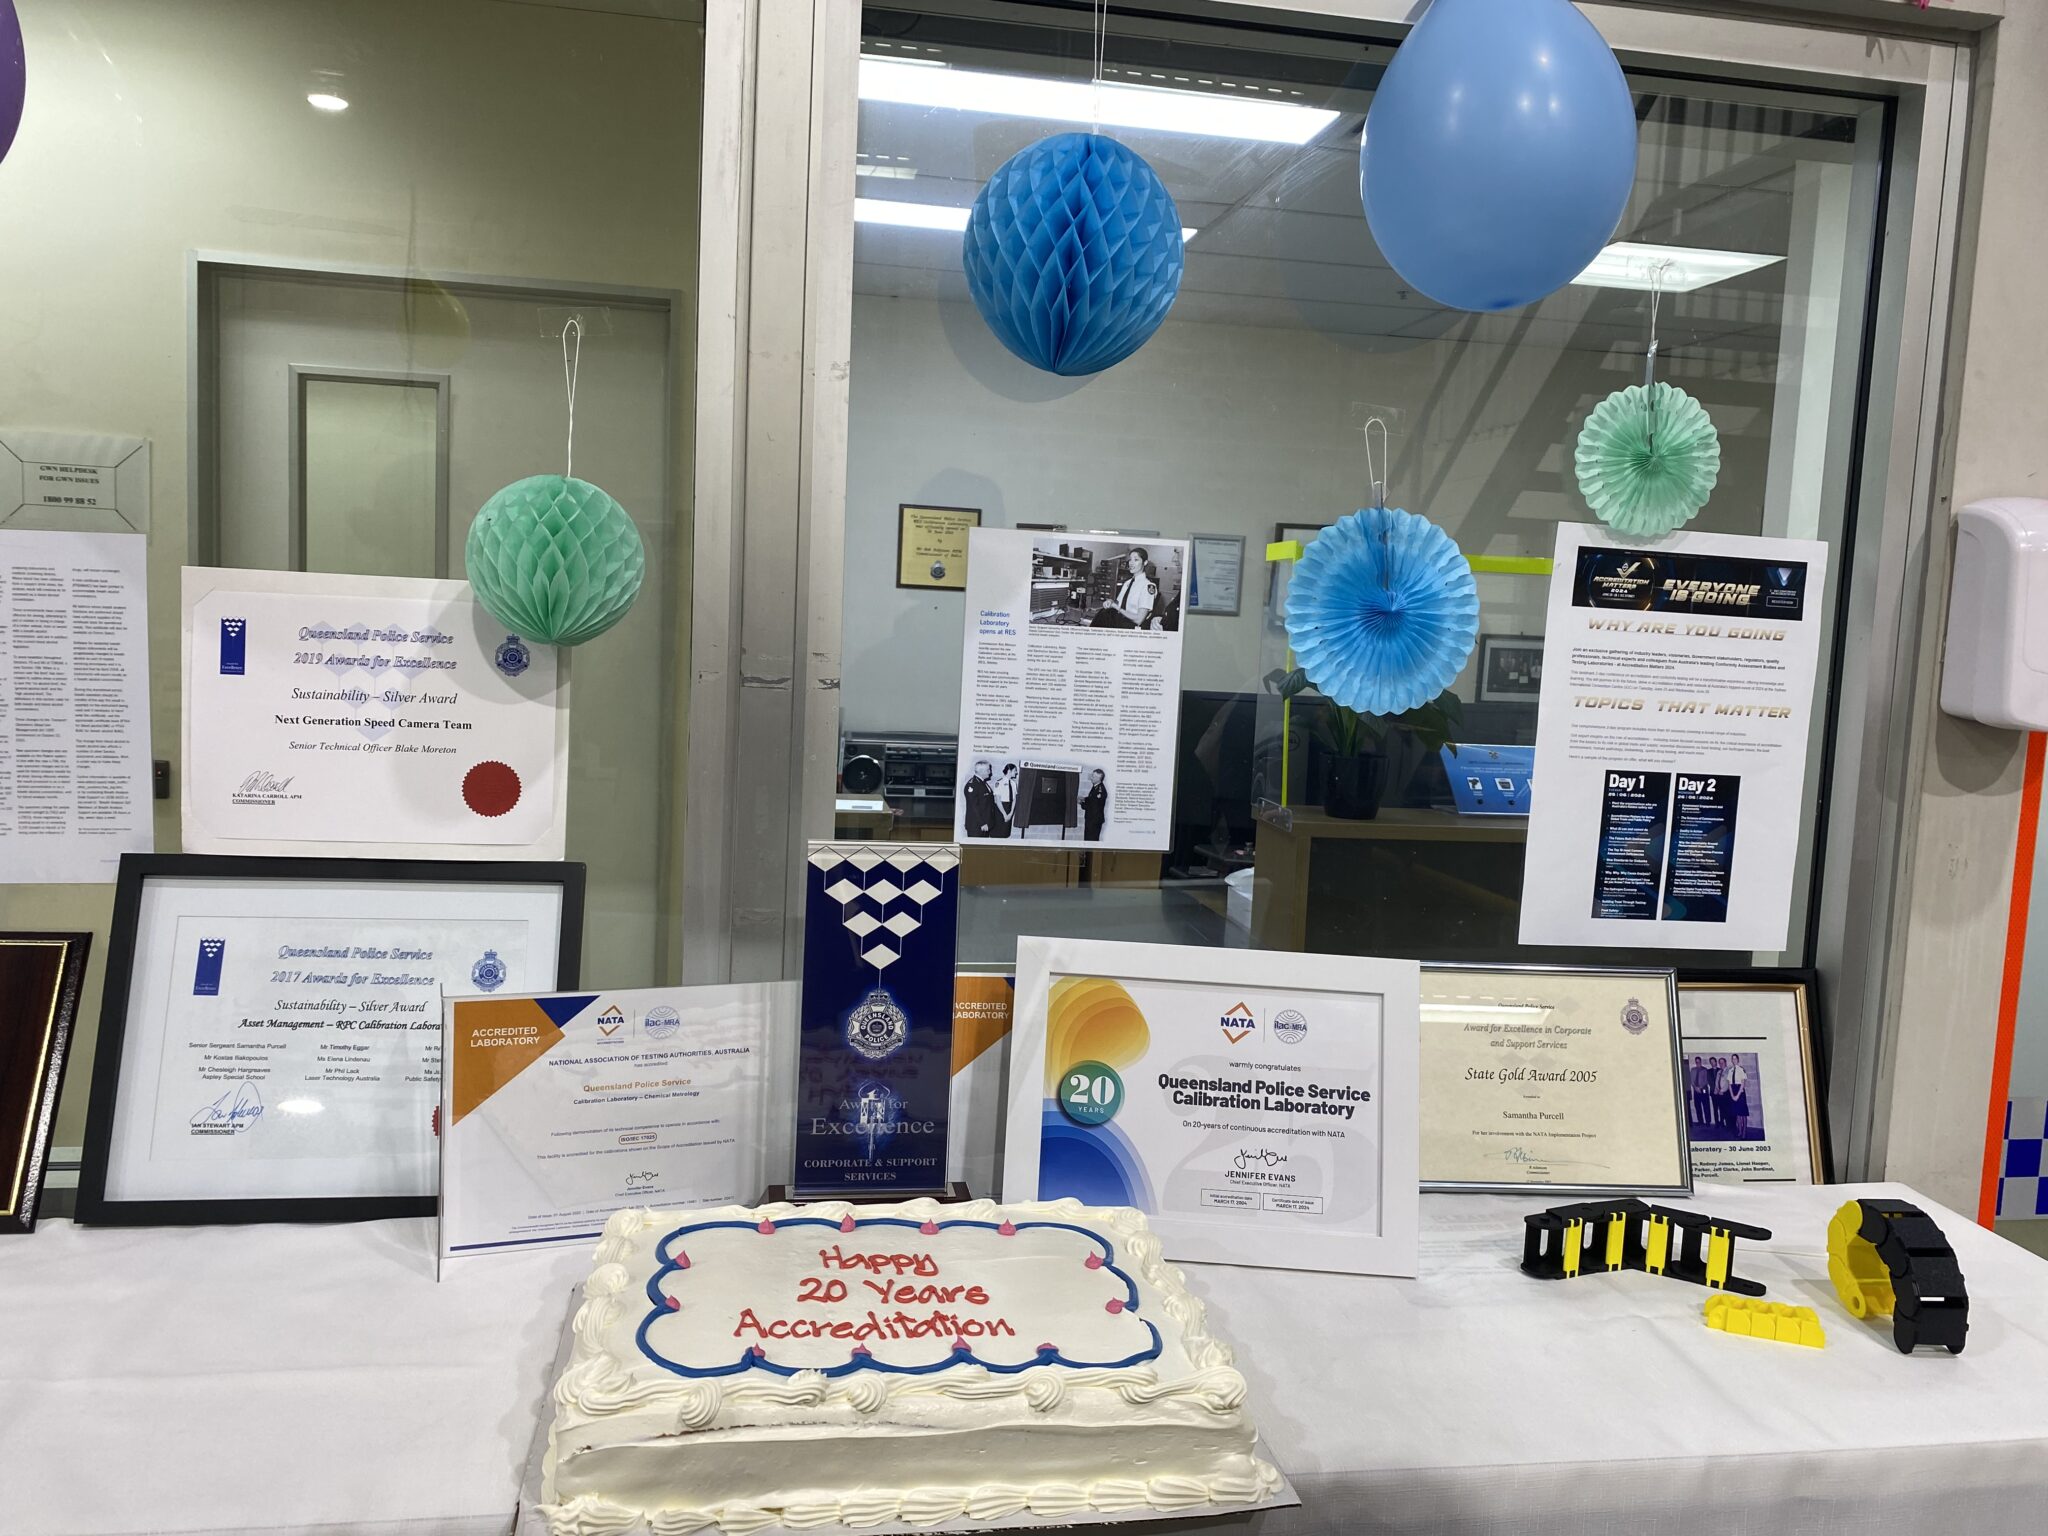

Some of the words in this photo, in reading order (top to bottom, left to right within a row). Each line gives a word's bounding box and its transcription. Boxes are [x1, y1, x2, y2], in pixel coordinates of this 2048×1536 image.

[1663, 578, 1761, 596] EVERYONE
[1669, 589, 1691, 602] IS
[1692, 591, 1751, 606] GOING
[980, 610, 1010, 618] Calibration
[299, 626, 370, 641] Queensland
[372, 628, 408, 643] Police
[410, 631, 454, 644] Service
[1588, 617, 1634, 632] WHY
[1637, 621, 1675, 634] ARE
[1684, 625, 1722, 637] YOU
[1728, 627, 1787, 641] GOING
[293, 652, 323, 665] 2019
[325, 654, 370, 667] Awards
[371, 655, 391, 669] for
[393, 656, 457, 670] Excellence
[292, 687, 370, 704] Sustainability
[383, 690, 417, 703] Silver
[418, 692, 458, 704] Award
[1573, 696, 1646, 711] TOPICS
[1657, 700, 1711, 714] THAT
[1714, 704, 1792, 719] MATTER
[275, 715, 300, 725] Next
[302, 715, 361, 726] Generation
[364, 717, 395, 729] Speed
[398, 718, 440, 729] Camera
[442, 720, 472, 730] Team
[289, 741, 317, 750] Senior
[319, 742, 360, 751] Technical
[362, 743, 393, 753] Officer
[394, 744, 419, 753] Blake
[421, 745, 457, 754] Moreton
[1609, 774, 1636, 791] Day
[1639, 775, 1645, 789] 1
[1678, 777, 1705, 794] Day
[1706, 778, 1717, 792] 2
[278, 945, 348, 959] Queensland
[351, 947, 388, 959] Police
[390, 948, 433, 960] Service
[270, 971, 301, 983] 2017
[302, 972, 347, 984] Awards
[347, 972, 368, 987] for
[370, 973, 434, 986] Excellence
[274, 1000, 347, 1014] Sustainability
[358, 1000, 389, 1012] Silver
[389, 1001, 427, 1013] Award
[954, 1002, 1008, 1010] ACCREDITED
[238, 1018, 264, 1028] Asset
[267, 1019, 324, 1031] Management
[358, 1020, 407, 1030] Calibration
[597, 1016, 625, 1025] NATA
[860, 1013, 894, 1030] QUEENSLAND
[1220, 1016, 1256, 1029] NATA
[472, 1026, 538, 1038] ACCREDITED
[1464, 1023, 1489, 1032] Award
[1489, 1024, 1501, 1033] for
[1503, 1024, 1543, 1034] Excellence
[1545, 1025, 1552, 1034] in
[1554, 1025, 1592, 1036] Corporate
[470, 1036, 540, 1048] LABORATORY
[864, 1034, 889, 1043] POLICE
[1505, 1040, 1535, 1050] Support
[1536, 1040, 1568, 1049] Services
[549, 1058, 583, 1067] NATIONAL
[584, 1055, 630, 1065] ASSOCIATION
[641, 1052, 669, 1061] TESTING
[714, 1047, 750, 1055] AUSTRALIA
[1229, 1061, 1253, 1070] warmly
[1254, 1062, 1301, 1072] congratulates
[1465, 1067, 1495, 1081] State
[1498, 1067, 1524, 1084] Gold
[1527, 1069, 1568, 1082] Award
[1569, 1070, 1598, 1083] 2005
[583, 1082, 633, 1092] Queensland
[635, 1080, 659, 1089] Police
[661, 1078, 692, 1087] Service
[1070, 1074, 1115, 1105] 20
[1158, 1073, 1252, 1094] Queensland
[1255, 1080, 1305, 1098] Police
[1308, 1084, 1371, 1102] Service
[573, 1097, 606, 1105] Calibration
[606, 1095, 638, 1104] Laboratory
[644, 1092, 671, 1100] Chemical
[672, 1089, 700, 1098] Metrology
[1173, 1090, 1261, 1110] Calibration
[1264, 1096, 1355, 1120] Laboratory
[1078, 1106, 1105, 1114] YEARS
[1503, 1111, 1537, 1120] Samantha
[1539, 1112, 1564, 1120] Purcell
[810, 1117, 935, 1136] Exceence
[1182, 1120, 1192, 1128] On
[1192, 1121, 1222, 1131] 20-years
[1222, 1122, 1229, 1130] of
[1230, 1124, 1266, 1133] continuous
[1267, 1126, 1310, 1136] accreditation
[1327, 1130, 1345, 1138] NATA
[804, 1159, 872, 1168] CORPORATE
[874, 1159, 883, 1167] &
[886, 1157, 938, 1167] SUPPORT
[844, 1172, 897, 1181] SERVICES
[1225, 1170, 1266, 1180] JENNIFER
[1268, 1173, 1296, 1182] EVANS
[819, 1245, 939, 1277] Happy
[797, 1278, 847, 1303] 20
[863, 1279, 990, 1304] Years
[733, 1308, 1016, 1340] Accreditation
